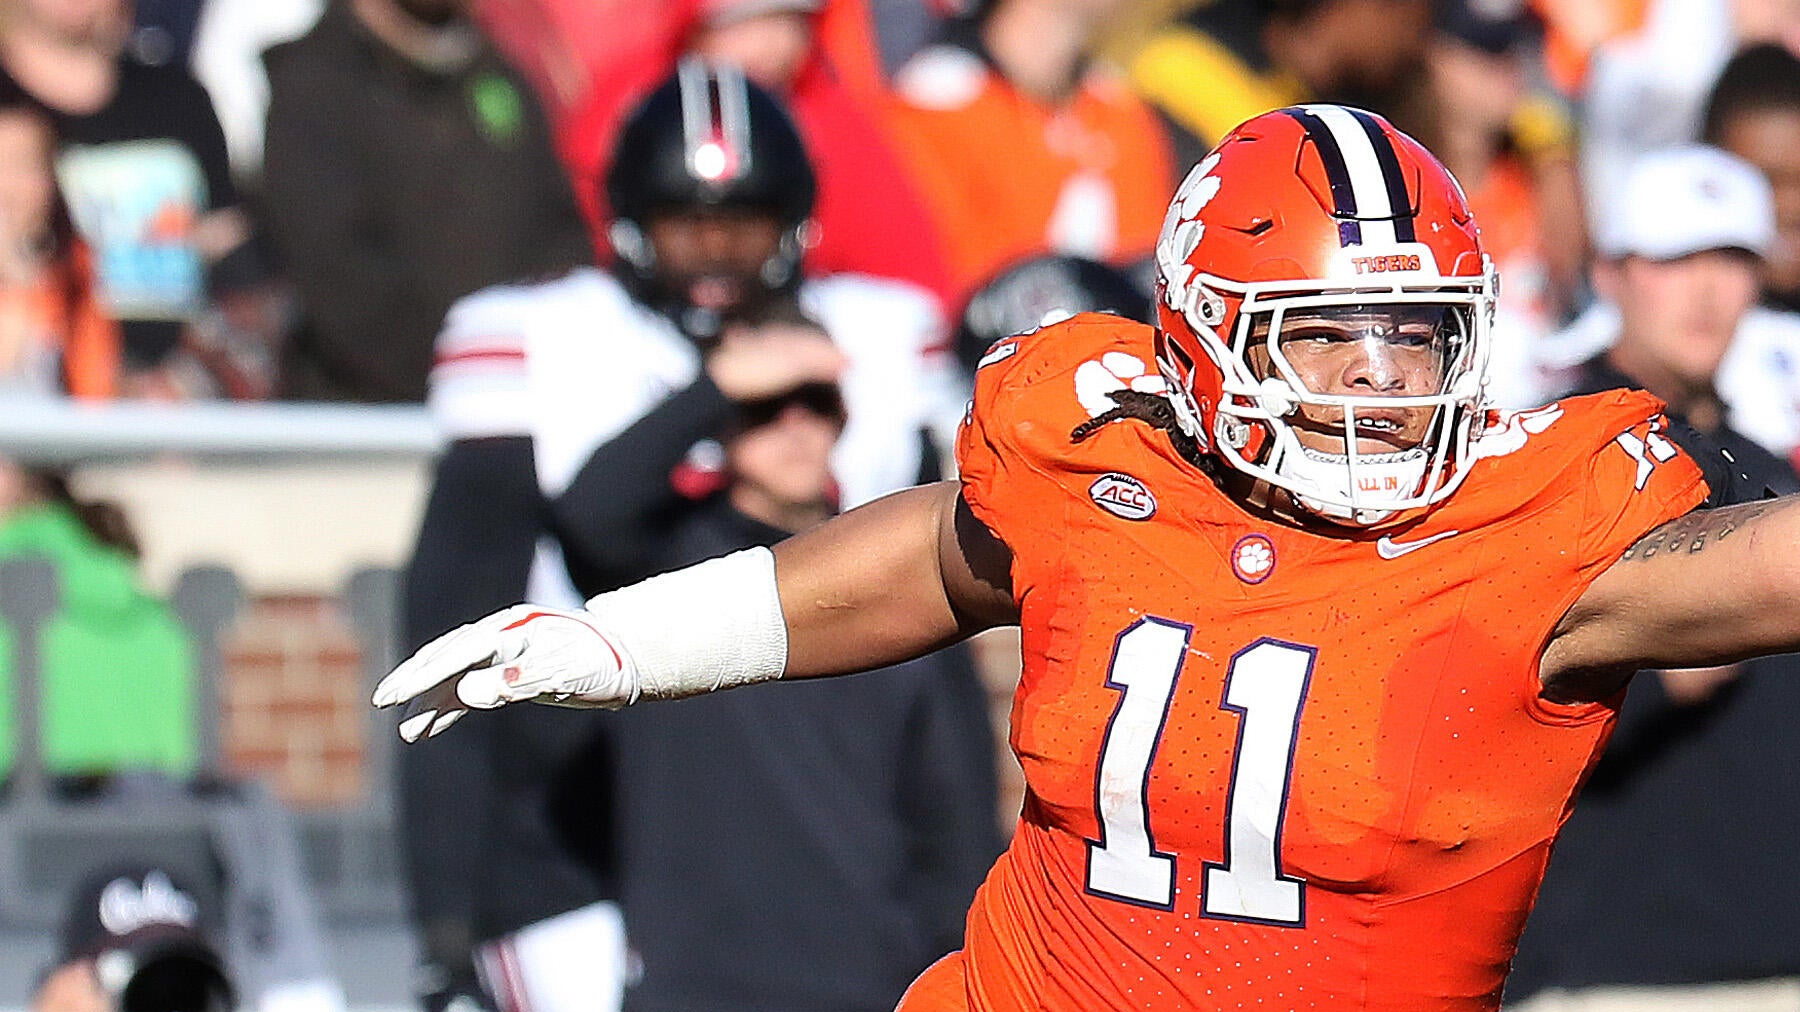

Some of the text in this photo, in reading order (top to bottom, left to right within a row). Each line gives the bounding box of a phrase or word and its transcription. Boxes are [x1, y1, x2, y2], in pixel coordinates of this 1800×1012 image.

[1351, 253, 1422, 275] TIGERS
[1383, 475, 1398, 490] IN
[1100, 485, 1147, 508] ACC
[1083, 614, 1318, 929] 11
